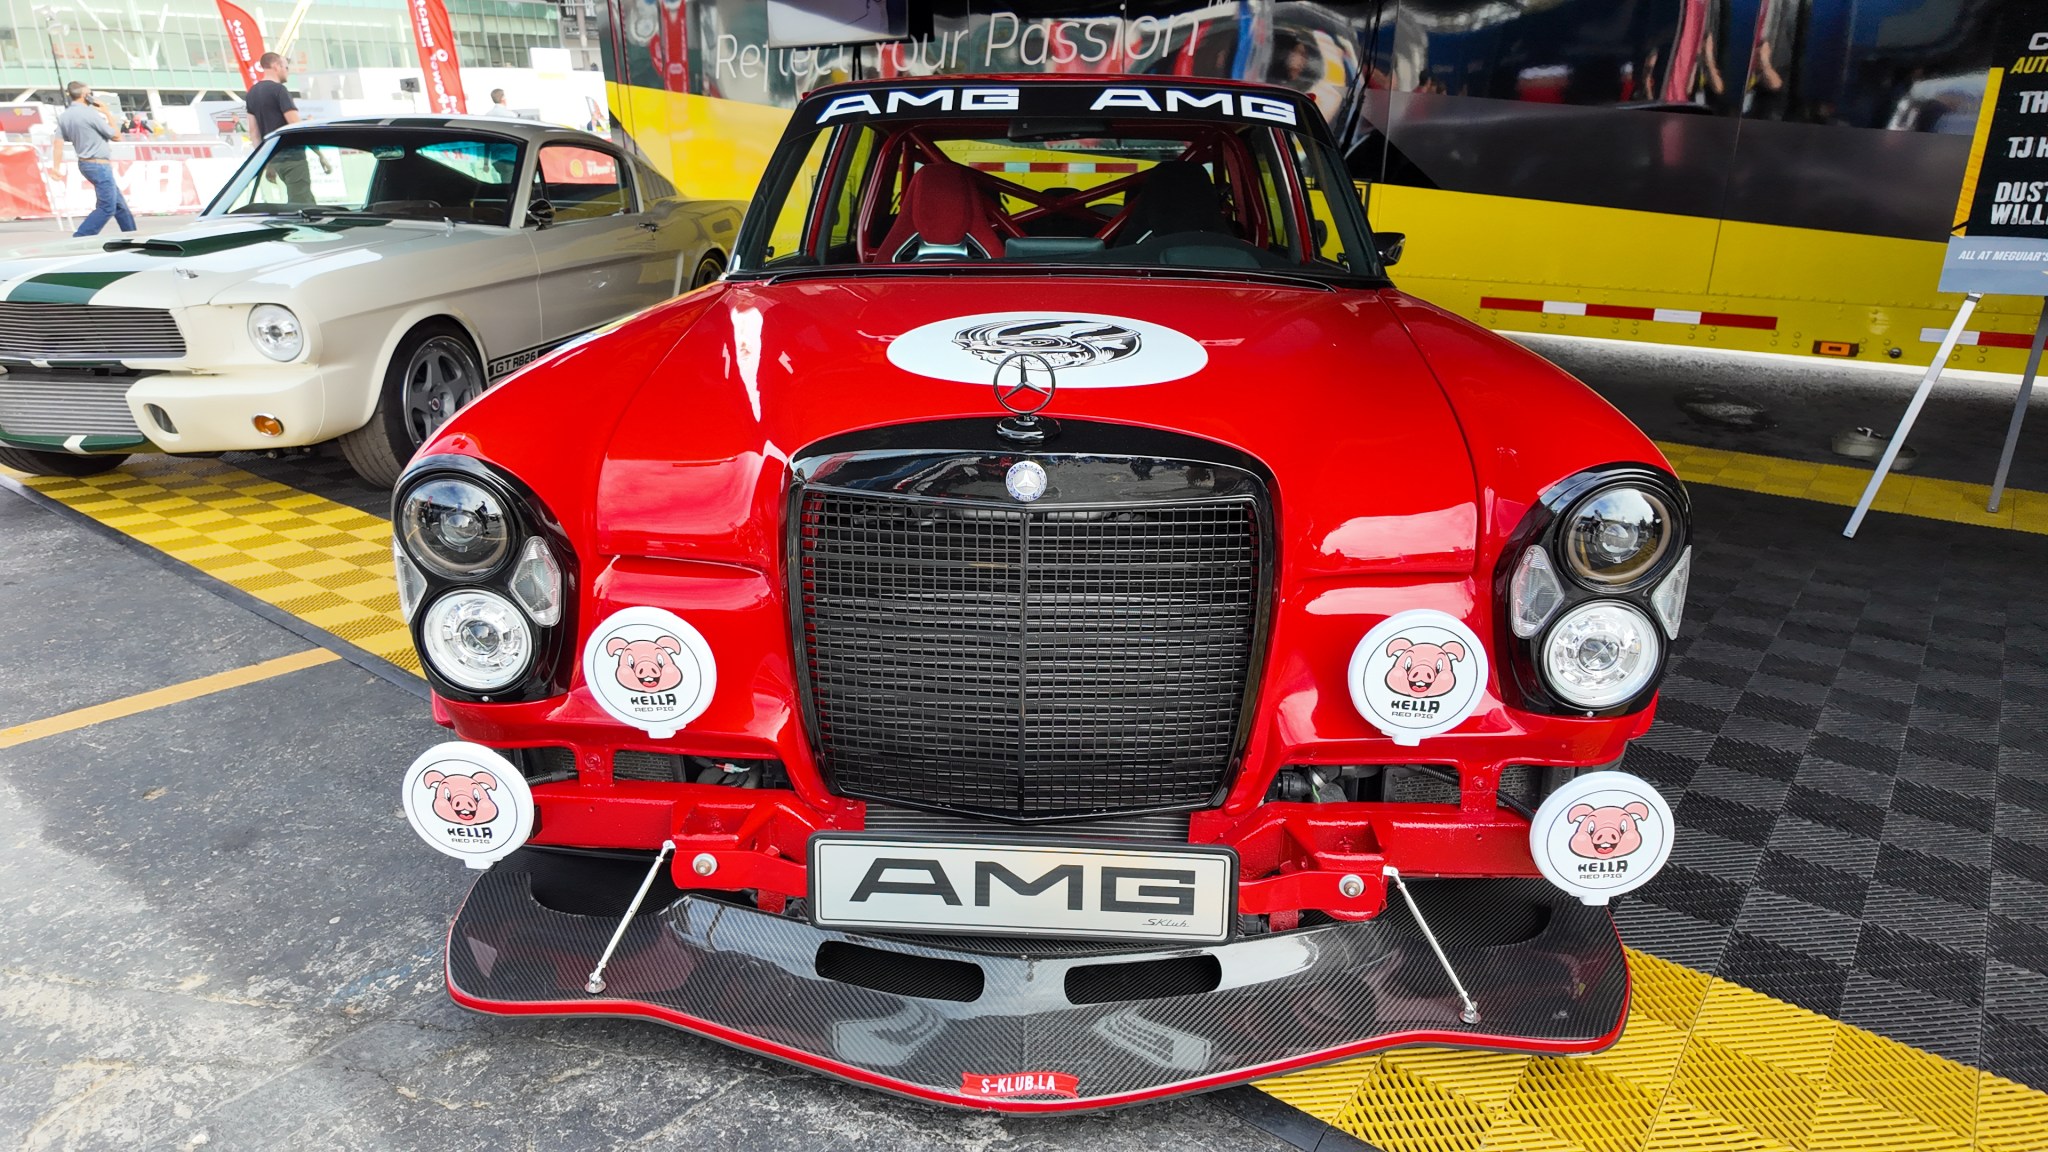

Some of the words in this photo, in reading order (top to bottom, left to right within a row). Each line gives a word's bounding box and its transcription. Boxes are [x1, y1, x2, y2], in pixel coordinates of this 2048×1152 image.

[984, 11, 1200, 67] Passion
[2009, 56, 2048, 73] AUT
[816, 88, 1020, 124] AMG
[1090, 88, 1297, 126] AMG
[2008, 136, 2034, 158] TJ
[1990, 203, 2048, 225] WILL
[1958, 250, 1976, 260] ALL
[1977, 250, 1993, 260] AT
[496, 360, 511, 373] GT
[849, 857, 1196, 916] AMG
[980, 1075, 1056, 1094] S-KLUB.LA
